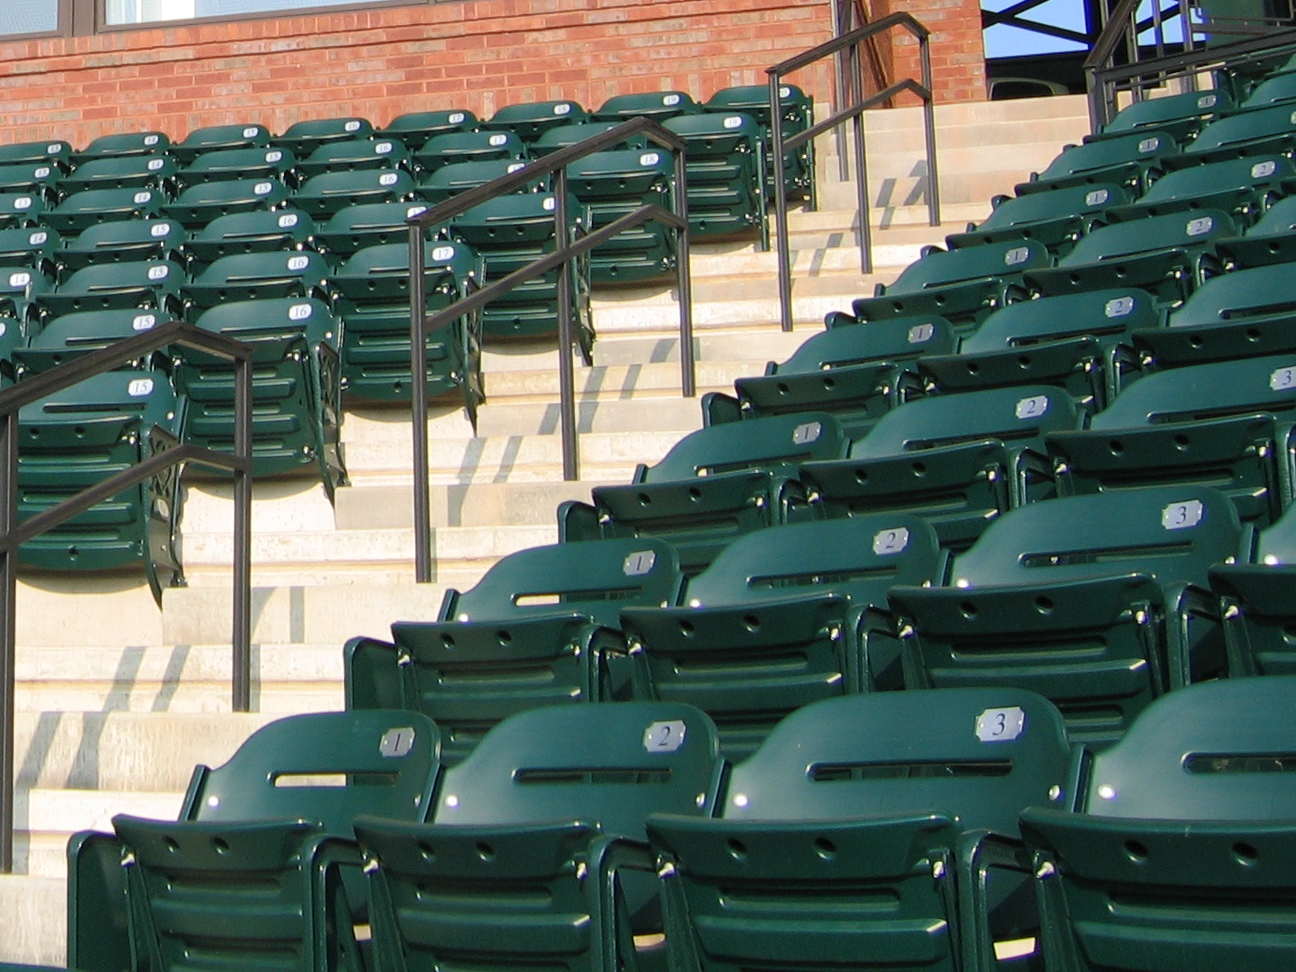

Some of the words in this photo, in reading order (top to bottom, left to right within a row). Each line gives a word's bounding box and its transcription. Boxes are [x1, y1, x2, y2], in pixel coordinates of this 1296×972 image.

[438, 247, 452, 259] 17
[293, 259, 305, 268] 16
[295, 306, 307, 317] 16
[1115, 300, 1123, 314] 2
[138, 316, 151, 328] 15
[918, 327, 923, 339] 1
[1282, 370, 1292, 386] 3
[135, 381, 148, 394] 15
[1026, 399, 1036, 414] 2
[804, 426, 810, 440] 1
[1176, 505, 1187, 525] 3
[885, 532, 896, 549] 2
[636, 555, 642, 571] 1
[992, 713, 1006, 736] 3
[394, 733, 401, 752] 1
[658, 725, 671, 747] 2
